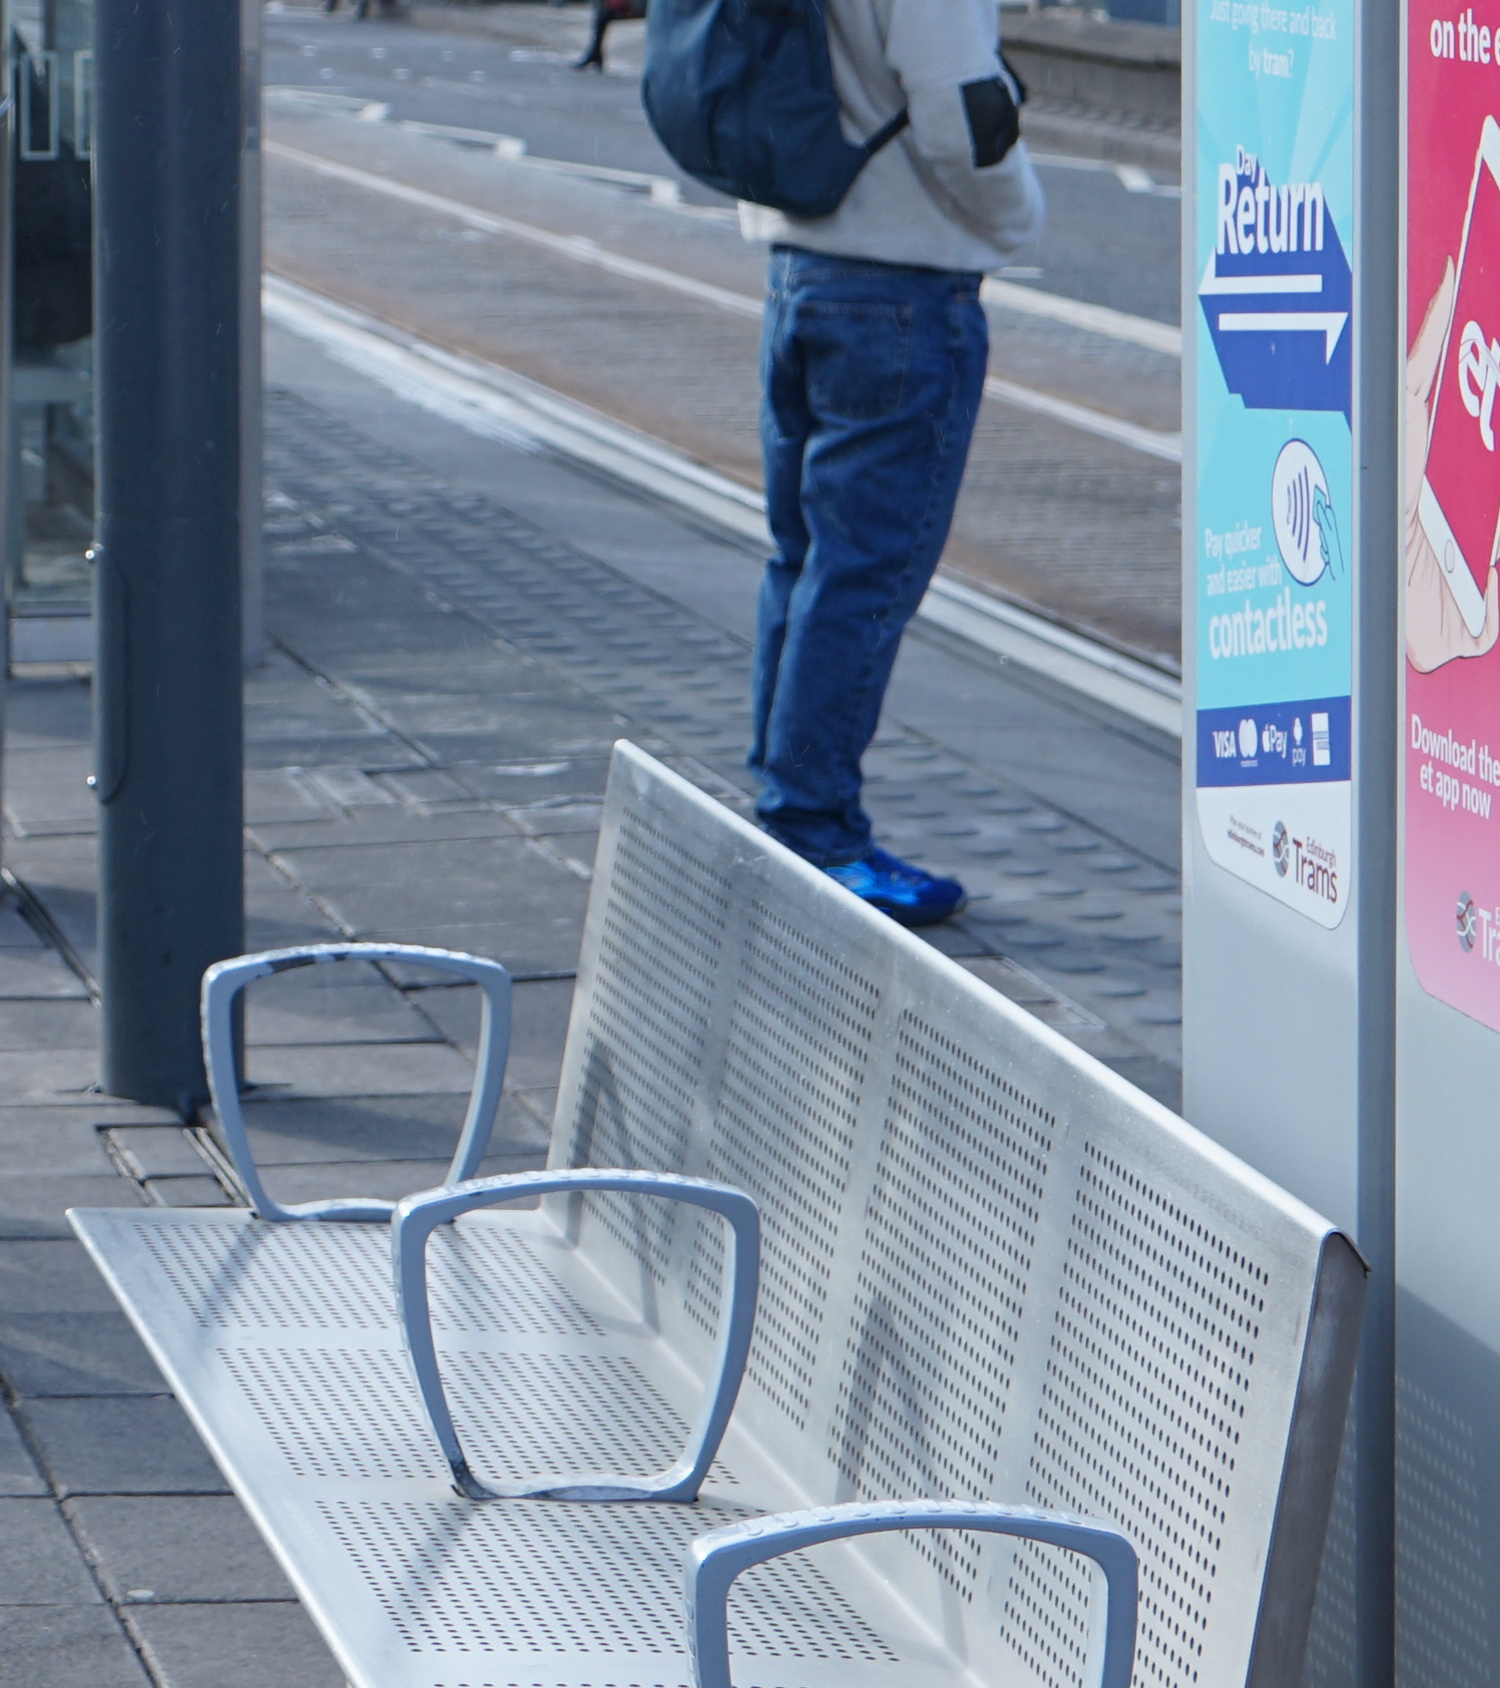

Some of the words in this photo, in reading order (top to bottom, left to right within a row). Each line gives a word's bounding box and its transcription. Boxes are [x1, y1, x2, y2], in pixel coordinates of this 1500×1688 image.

[1261, 0, 1288, 32] there
[1290, 5, 1310, 36] and
[1312, 5, 1337, 40] back
[1430, 18, 1455, 59] on
[1458, 8, 1491, 65] the
[1248, 41, 1260, 79] by
[1263, 46, 1294, 78] tram?
[1236, 143, 1257, 183] Day
[1216, 162, 1324, 255] Return
[1205, 528, 1222, 561] Pay
[1225, 520, 1261, 559] quicker
[1207, 563, 1224, 595] and
[1227, 559, 1256, 592] easier
[1258, 554, 1282, 587] with
[1209, 586, 1328, 660] contactless
[1212, 730, 1237, 758] VISA
[1270, 724, 1287, 759] Pay
[1411, 713, 1476, 775] Download
[1479, 745, 1500, 786] the
[1420, 760, 1433, 792] et
[1436, 771, 1460, 811] app
[1462, 784, 1491, 819] now
[1293, 838, 1337, 903] Trams
[1307, 836, 1337, 868] Edinburgh
